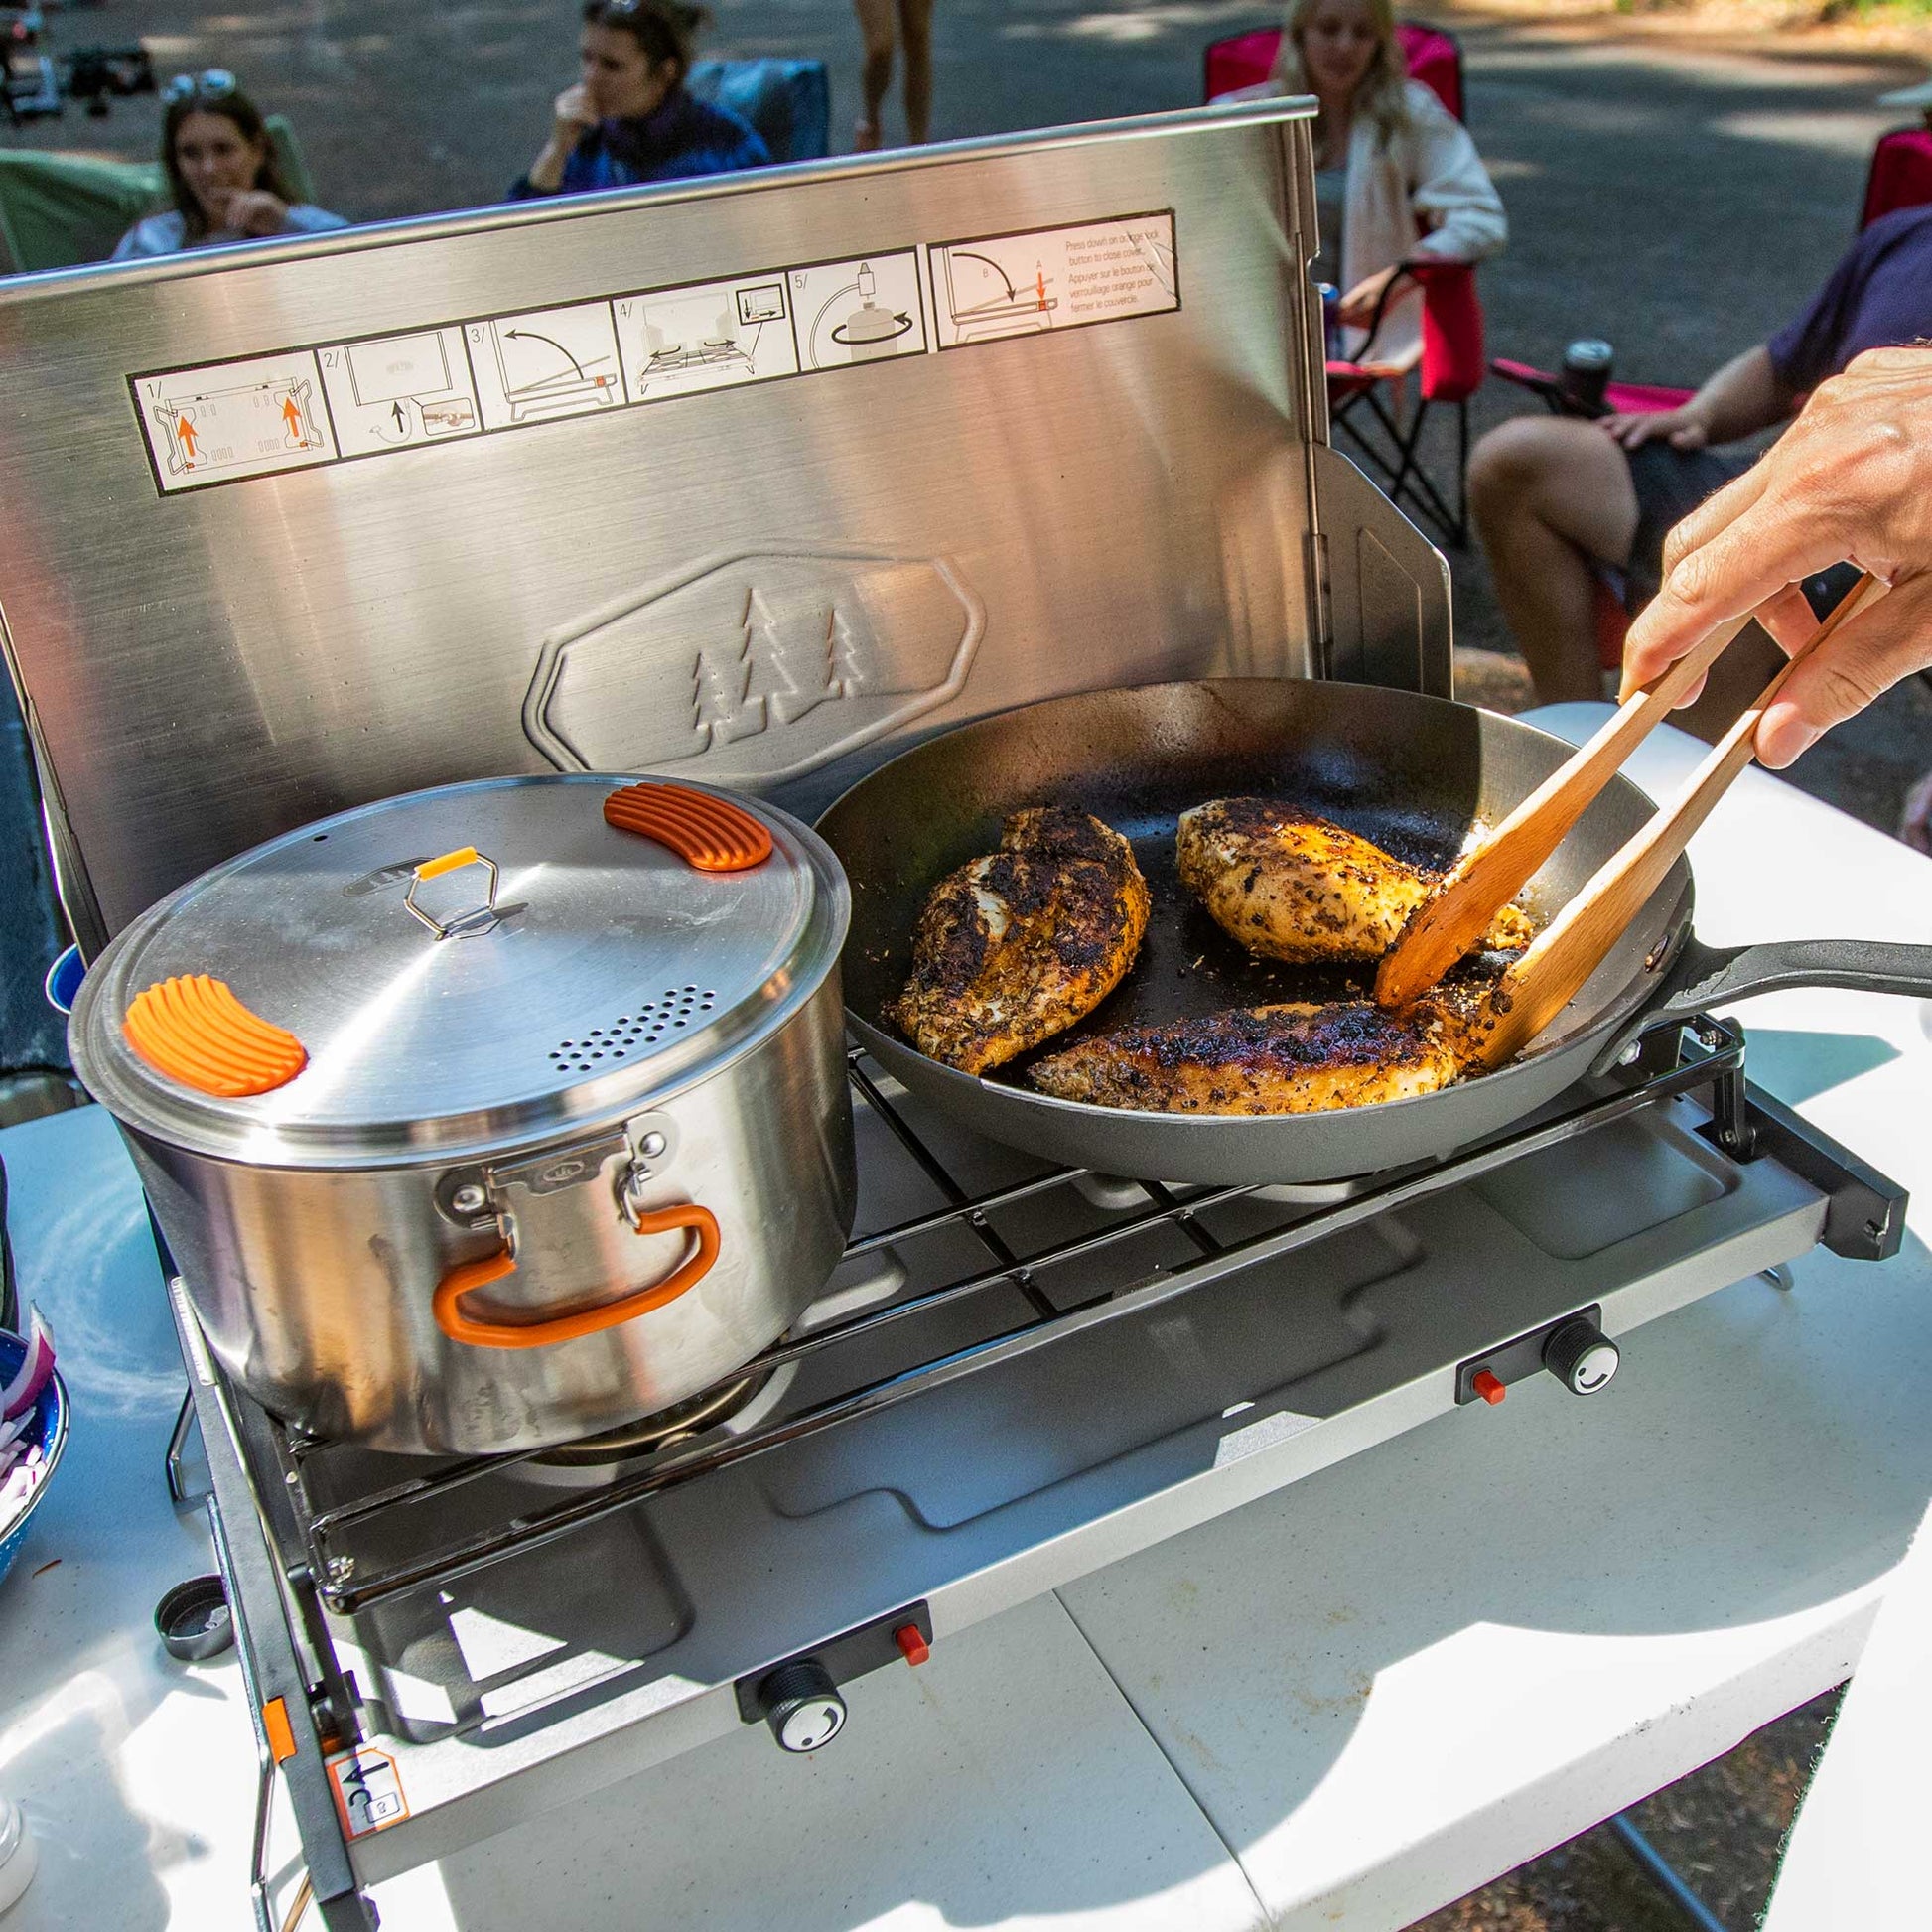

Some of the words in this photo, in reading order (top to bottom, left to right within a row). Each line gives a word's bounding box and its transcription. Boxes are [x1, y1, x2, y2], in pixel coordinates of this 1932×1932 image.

[1065, 241, 1085, 251] Press
[1087, 238, 1108, 248] down
[1069, 256, 1093, 266] button
[1104, 251, 1121, 261] close
[1068, 271, 1097, 284] Appuyer
[1113, 267, 1121, 276] le
[1121, 264, 1145, 275] bouton
[1112, 281, 1135, 292] orange
[1138, 278, 1153, 289] pour
[1071, 301, 1094, 312] fermer
